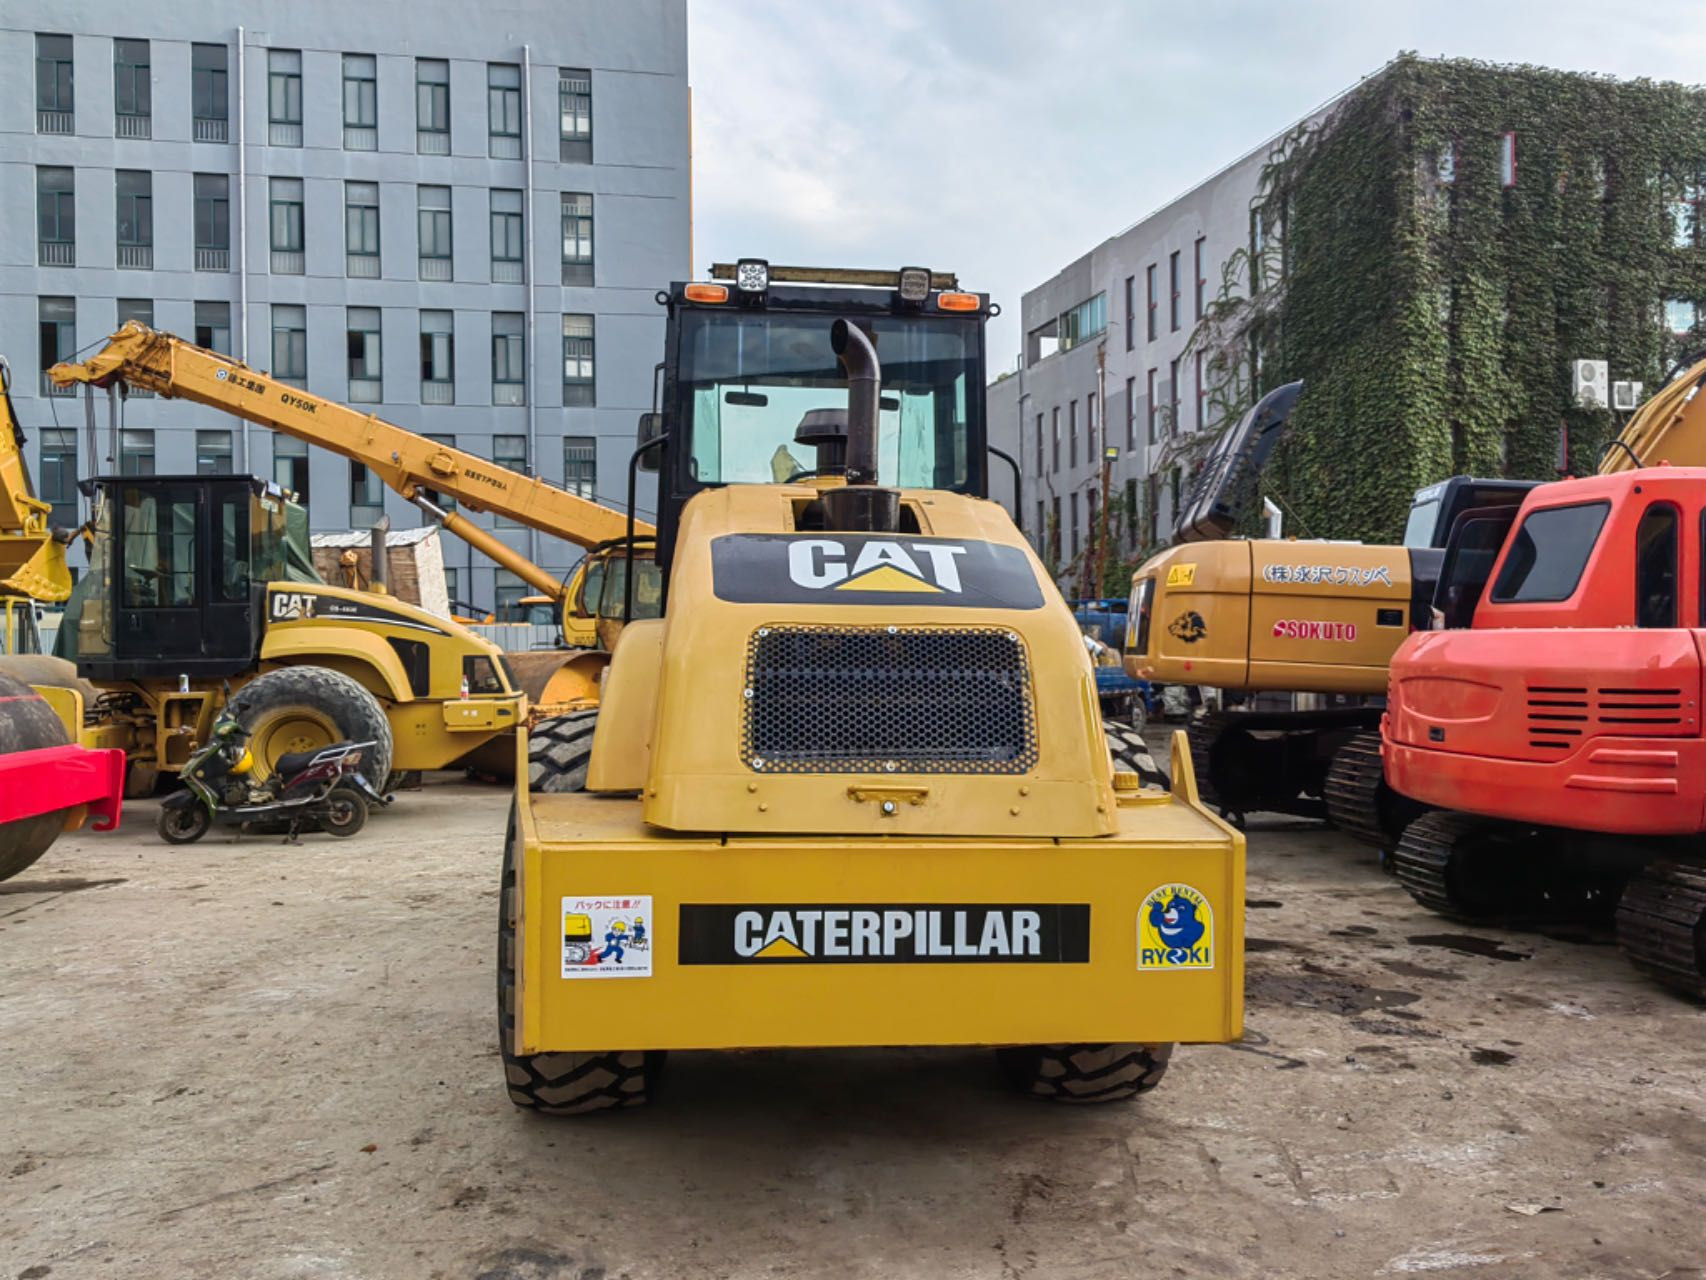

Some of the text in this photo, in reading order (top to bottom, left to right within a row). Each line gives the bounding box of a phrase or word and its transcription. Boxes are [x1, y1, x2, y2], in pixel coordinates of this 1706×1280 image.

[788, 539, 967, 594] CAT
[273, 593, 317, 618] CAT
[1287, 620, 1357, 642] SOKUTO
[734, 910, 1041, 957] CATERPILLAR
[1142, 947, 1209, 965] RYOKI
